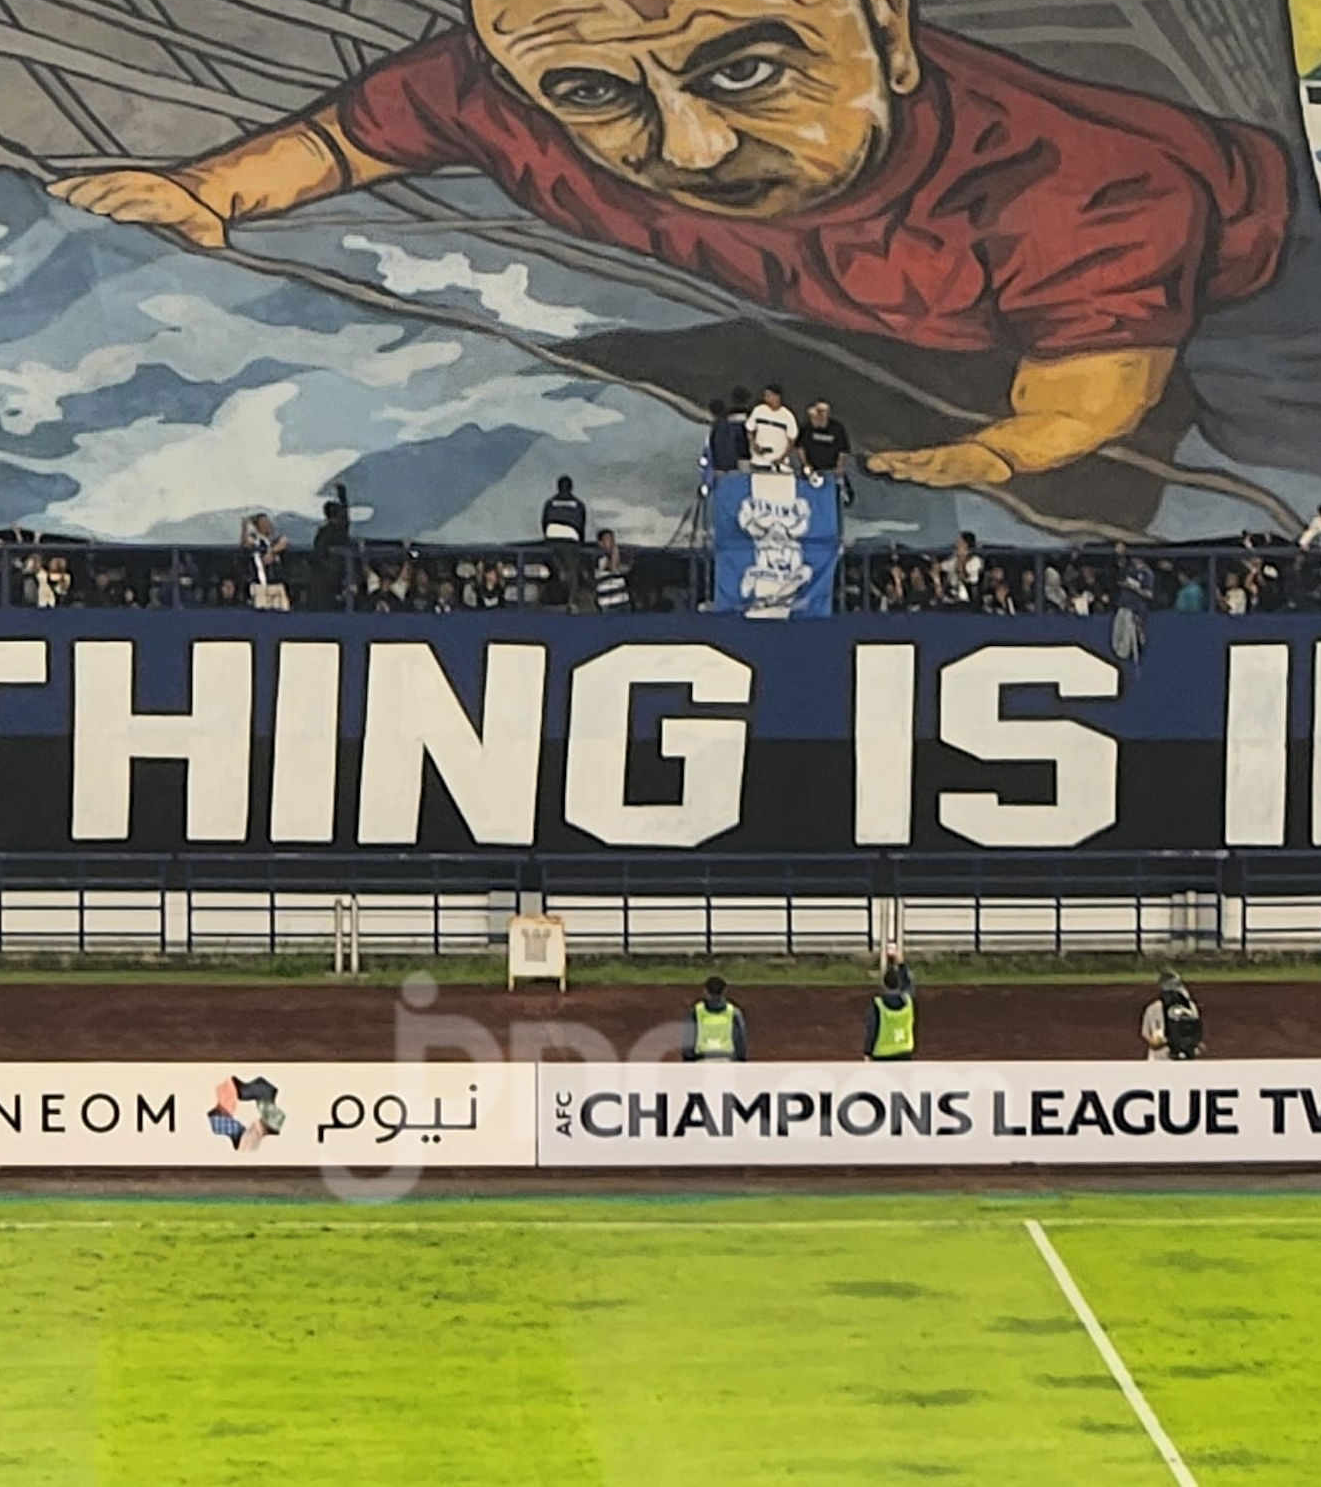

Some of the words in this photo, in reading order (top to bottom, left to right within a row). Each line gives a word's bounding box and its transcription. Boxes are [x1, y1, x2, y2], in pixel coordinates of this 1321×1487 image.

[855, 643, 1119, 846] IS
[317, 1084, 478, 1144] نيوم
[556, 1091, 573, 1138] AFC
[579, 1090, 973, 1139] CHAMPIONS
[993, 1088, 1240, 1137] LEAGUE
